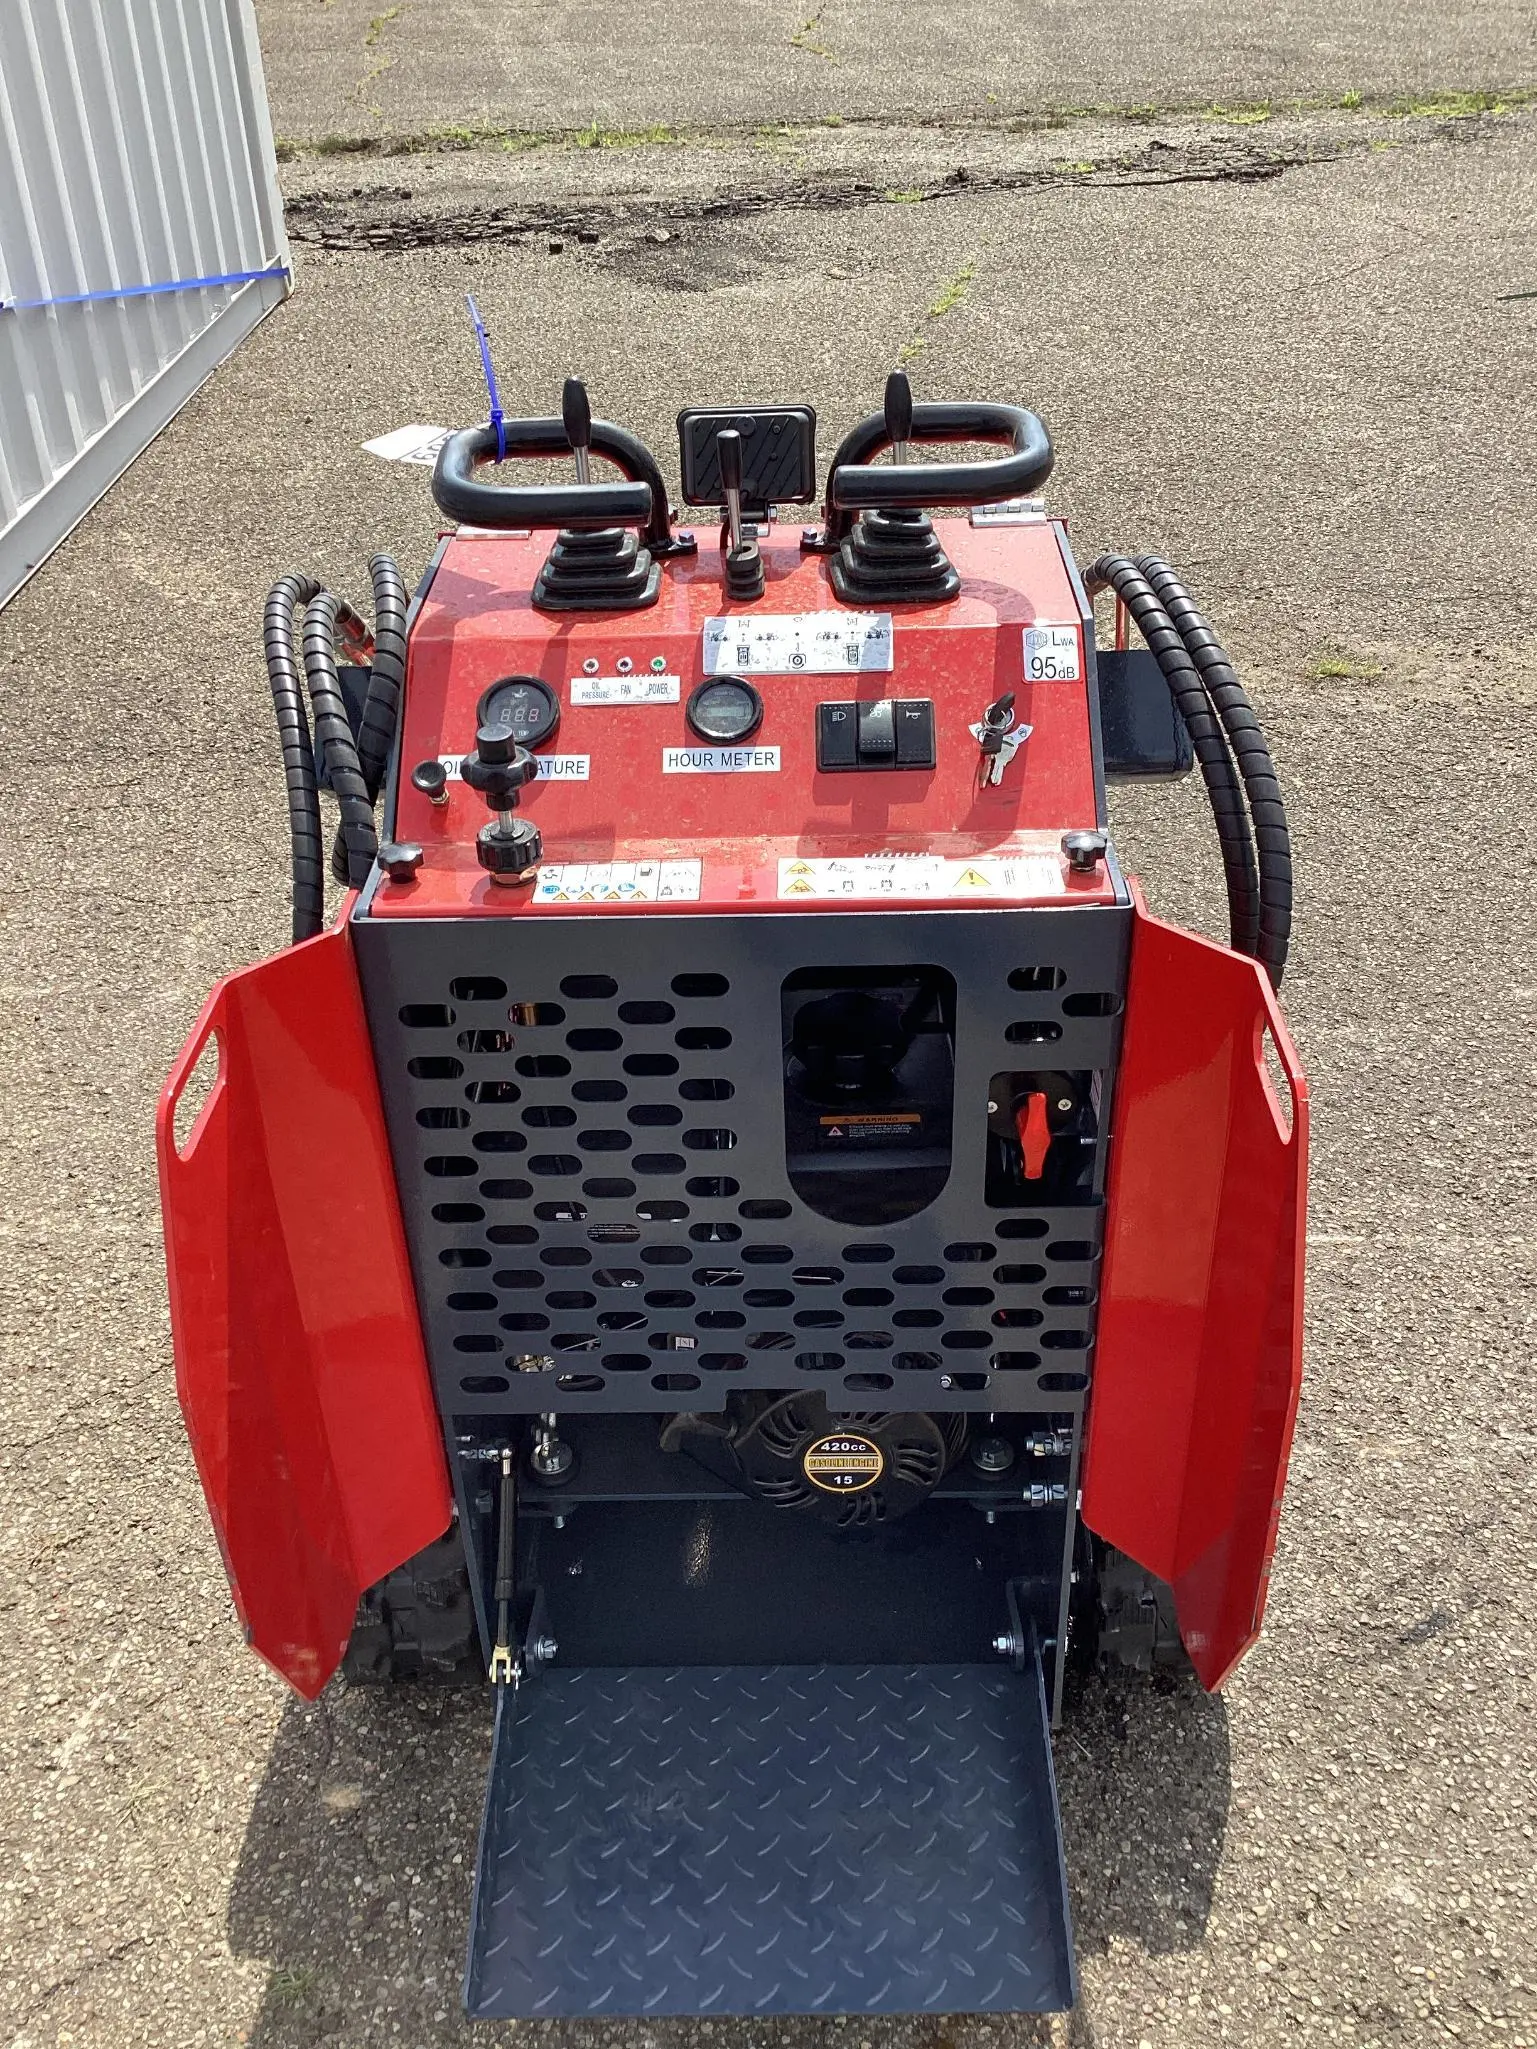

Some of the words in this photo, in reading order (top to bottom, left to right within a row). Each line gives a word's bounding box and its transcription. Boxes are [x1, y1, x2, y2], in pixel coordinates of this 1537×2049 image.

[581, 690, 609, 699] PRESSURE
[620, 684, 632, 695] FAN
[648, 683, 669, 695] POWER
[668, 753, 714, 767] HOUR
[721, 752, 775, 766] METER
[820, 1442, 866, 1451] 420cc
[809, 1458, 848, 1468] GASOLINE
[849, 1457, 878, 1468] ENGINE
[834, 1475, 852, 1485] 15
